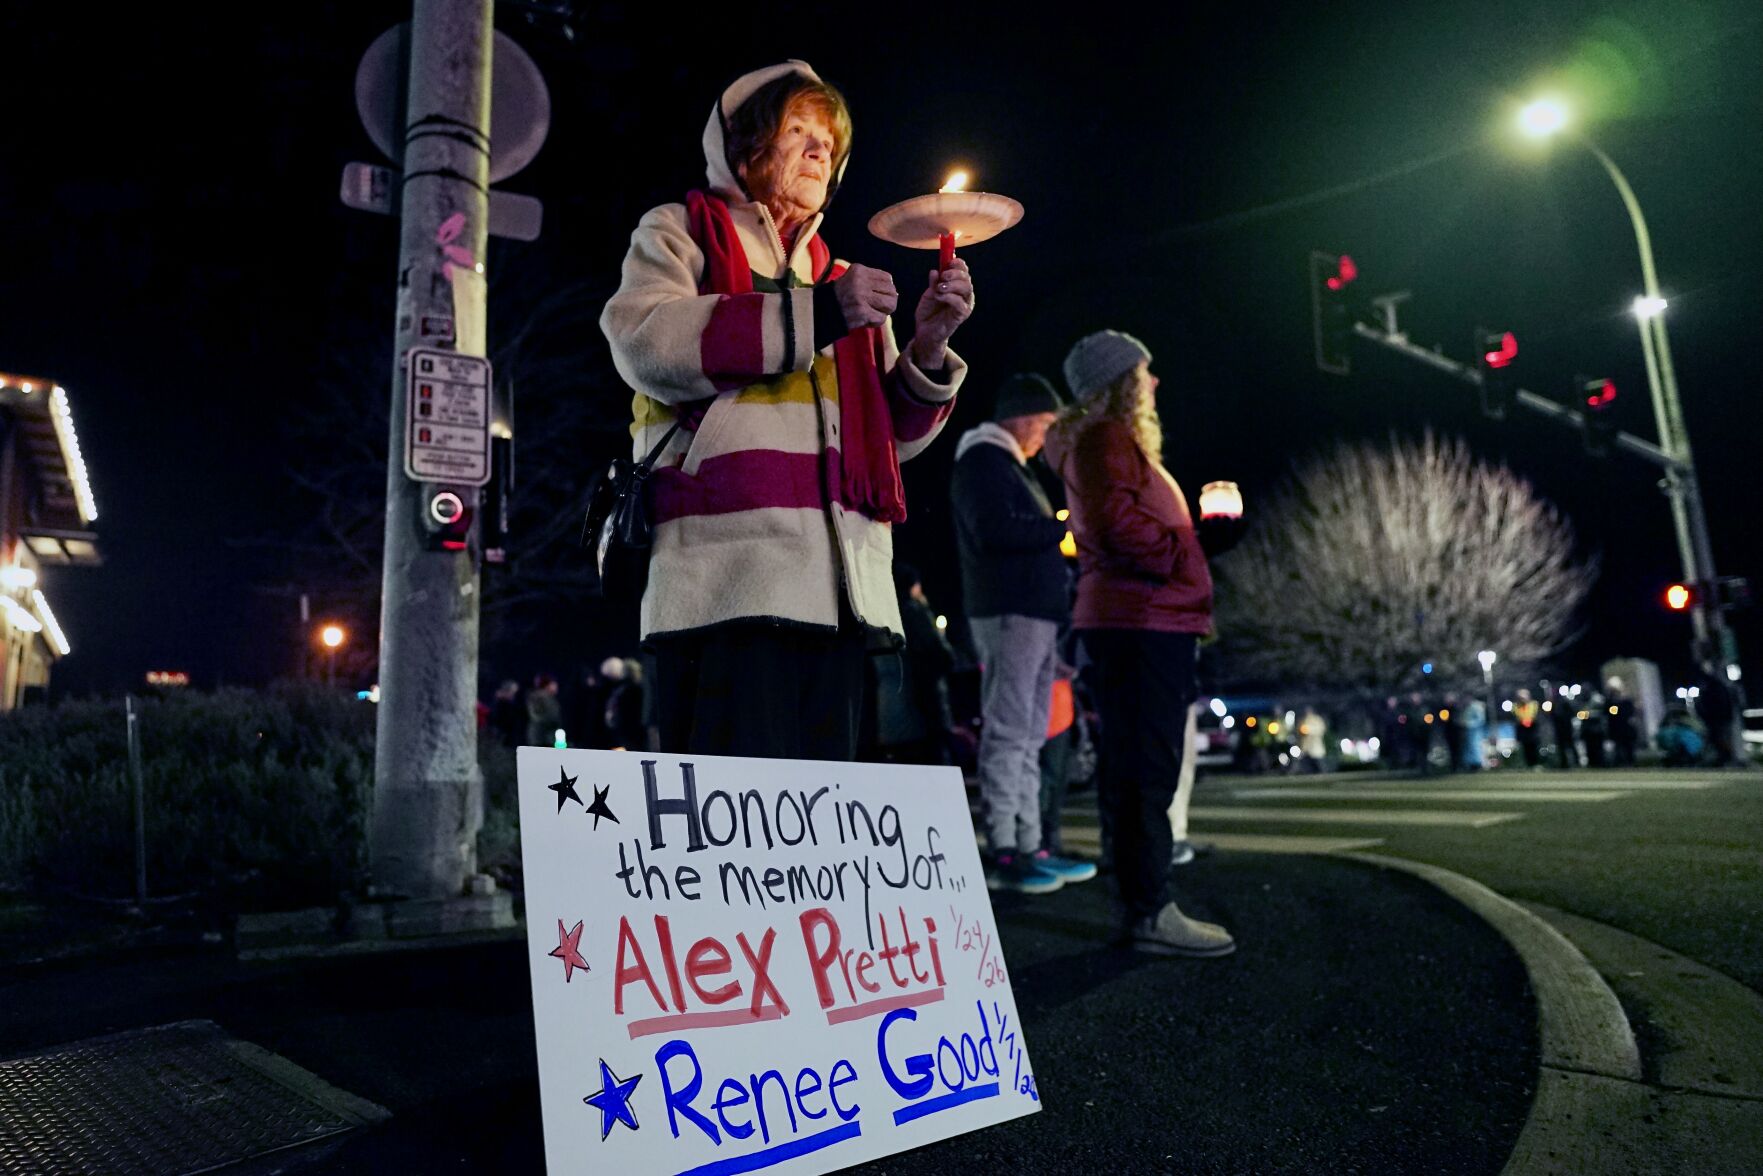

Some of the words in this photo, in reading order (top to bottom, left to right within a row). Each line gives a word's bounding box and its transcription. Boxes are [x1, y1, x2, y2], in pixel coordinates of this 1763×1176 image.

[640, 760, 909, 888] Honoring
[615, 839, 701, 899] the
[718, 855, 874, 950] memory
[614, 914, 791, 1018] Alex
[799, 906, 946, 1010] Pretti
[655, 1039, 861, 1146] Renee
[877, 1000, 1000, 1101] Good
